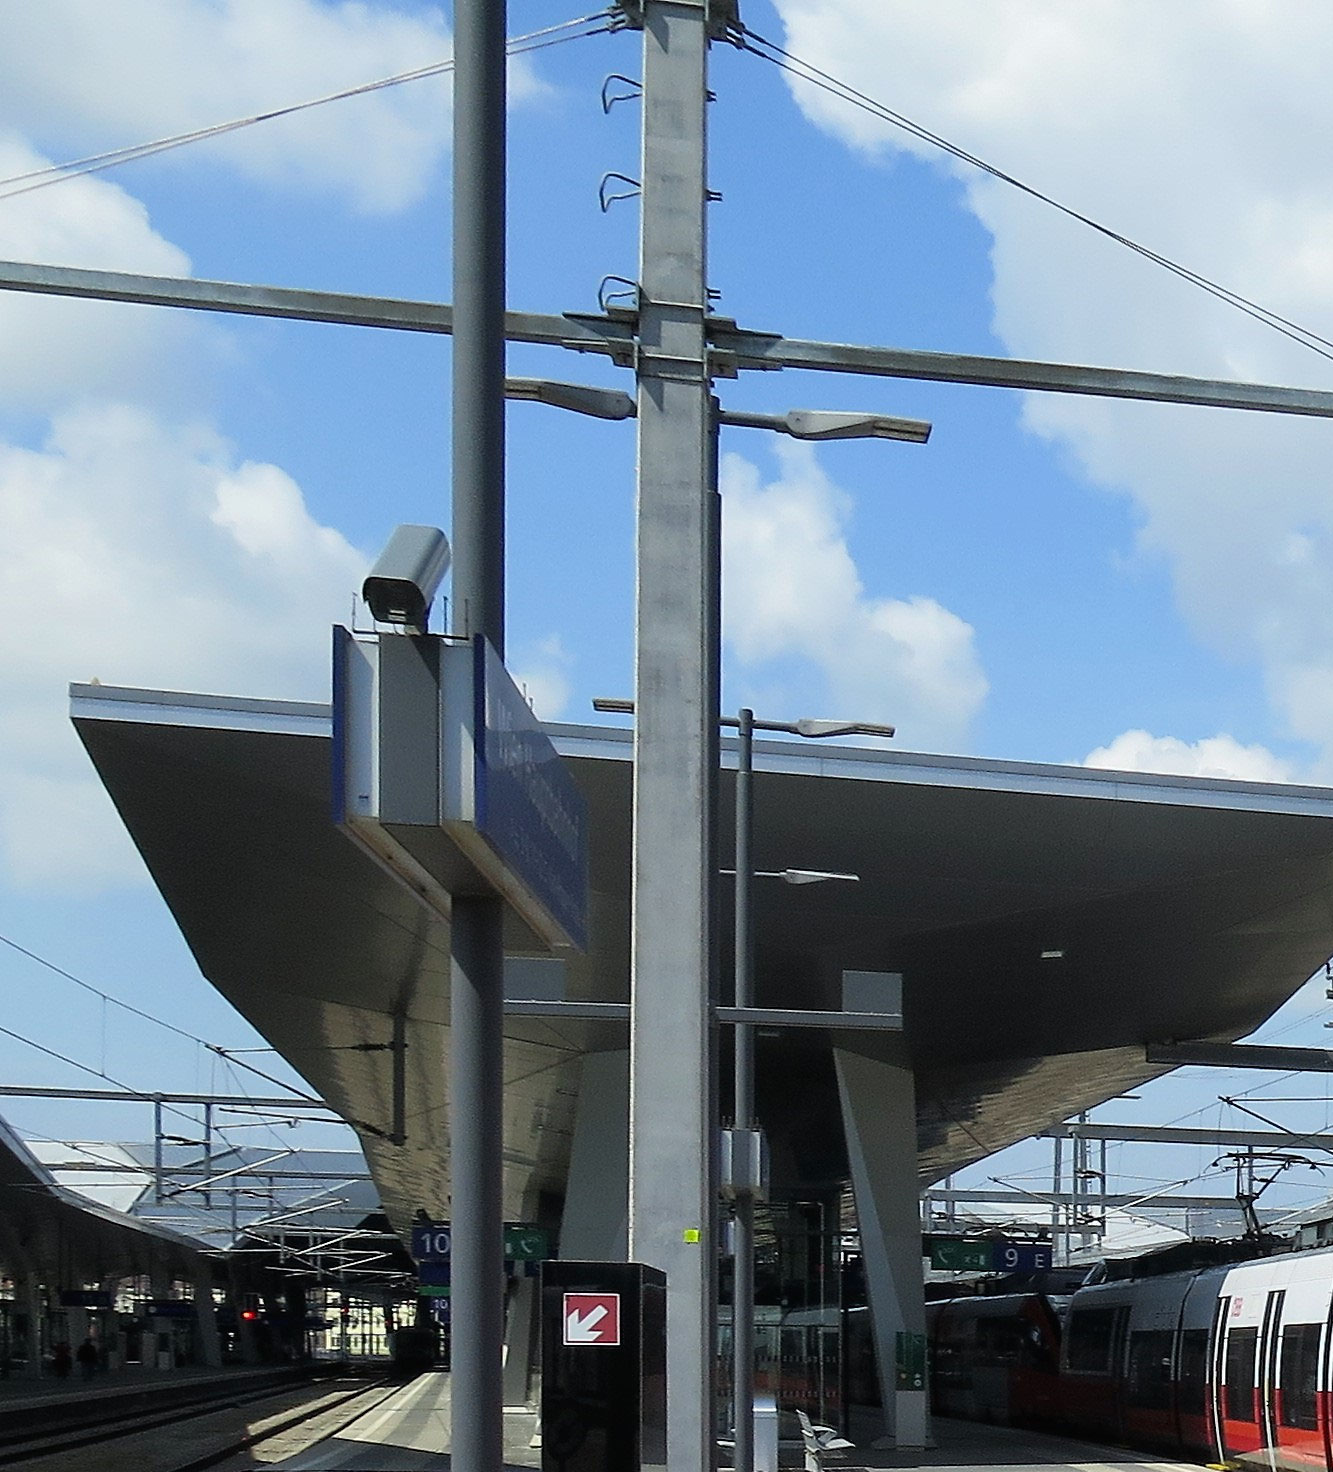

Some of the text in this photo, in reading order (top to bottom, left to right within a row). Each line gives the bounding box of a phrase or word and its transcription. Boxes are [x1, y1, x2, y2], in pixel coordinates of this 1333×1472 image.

[420, 1233, 450, 1254] 10
[1005, 1248, 1045, 1268] 9 E
